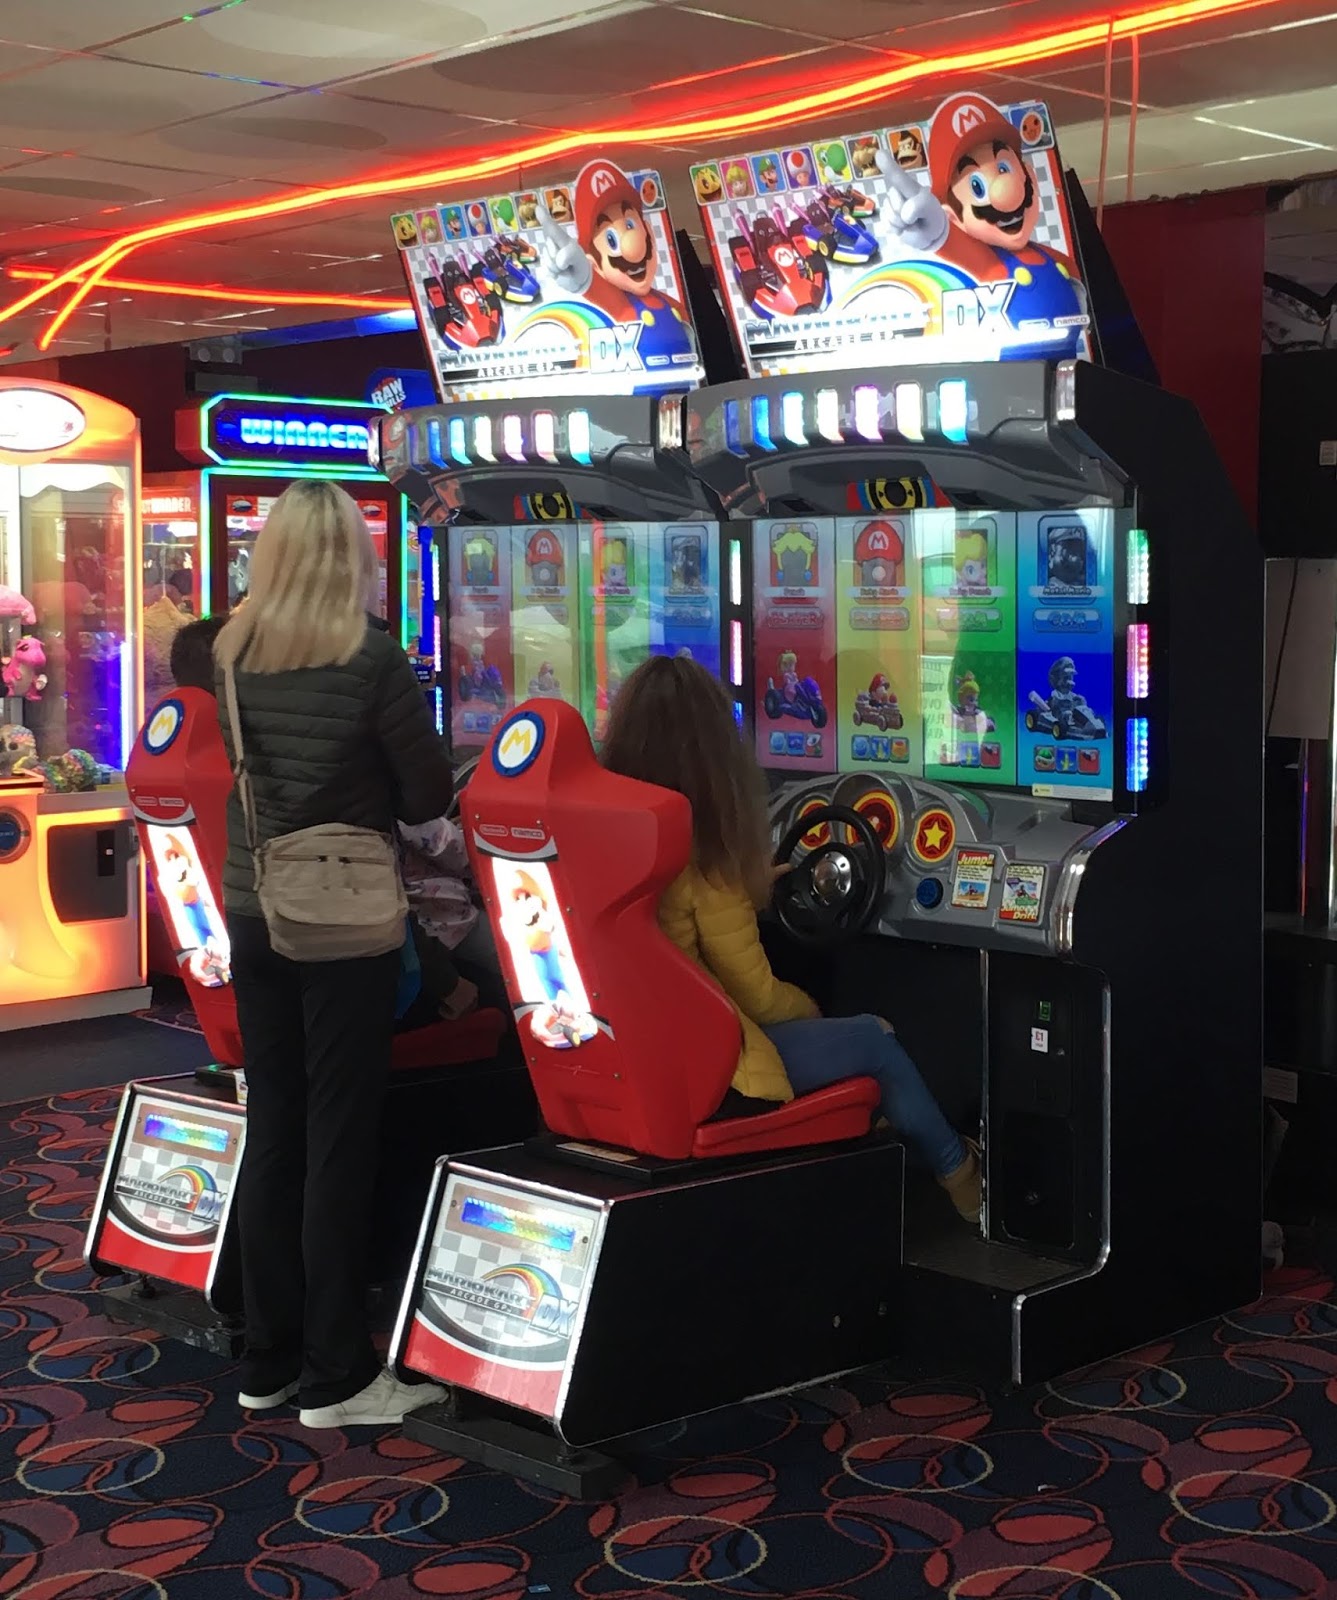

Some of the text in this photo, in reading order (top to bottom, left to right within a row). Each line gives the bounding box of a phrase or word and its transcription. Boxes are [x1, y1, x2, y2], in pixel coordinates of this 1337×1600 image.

[1055, 315, 1089, 326] namco
[371, 377, 403, 405] RAW
[240, 418, 369, 450] WINNER
[450, 1288, 490, 1305] ARCADE
[529, 1293, 580, 1339] DX
